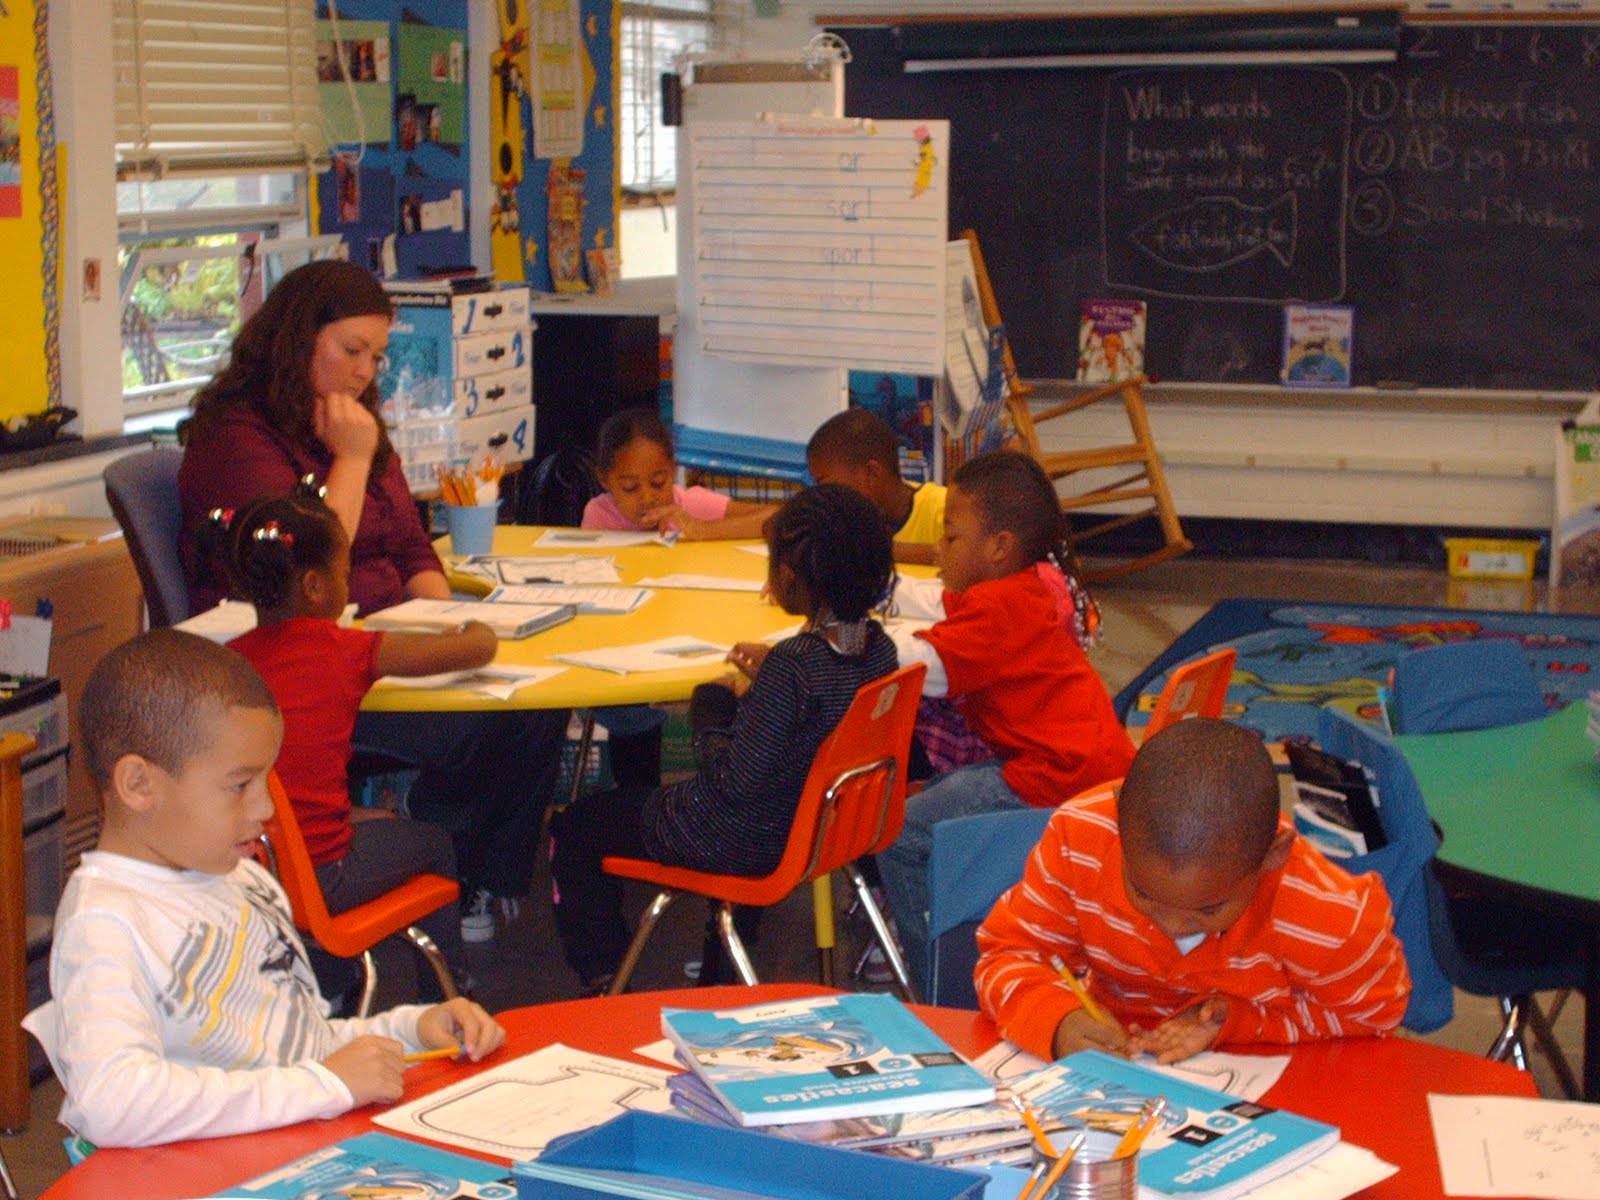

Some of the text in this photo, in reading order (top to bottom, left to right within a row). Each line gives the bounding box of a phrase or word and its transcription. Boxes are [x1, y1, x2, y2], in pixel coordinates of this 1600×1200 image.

[1528, 29, 1555, 63] 6
[1121, 84, 1272, 121] What words
[1400, 125, 1455, 172] AB
[462, 298, 477, 335] 1
[511, 332, 526, 368] 2
[463, 377, 480, 417] 3
[511, 418, 528, 454] 4
[842, 1064, 861, 1077] 1
[763, 1077, 922, 1103] seacastles
